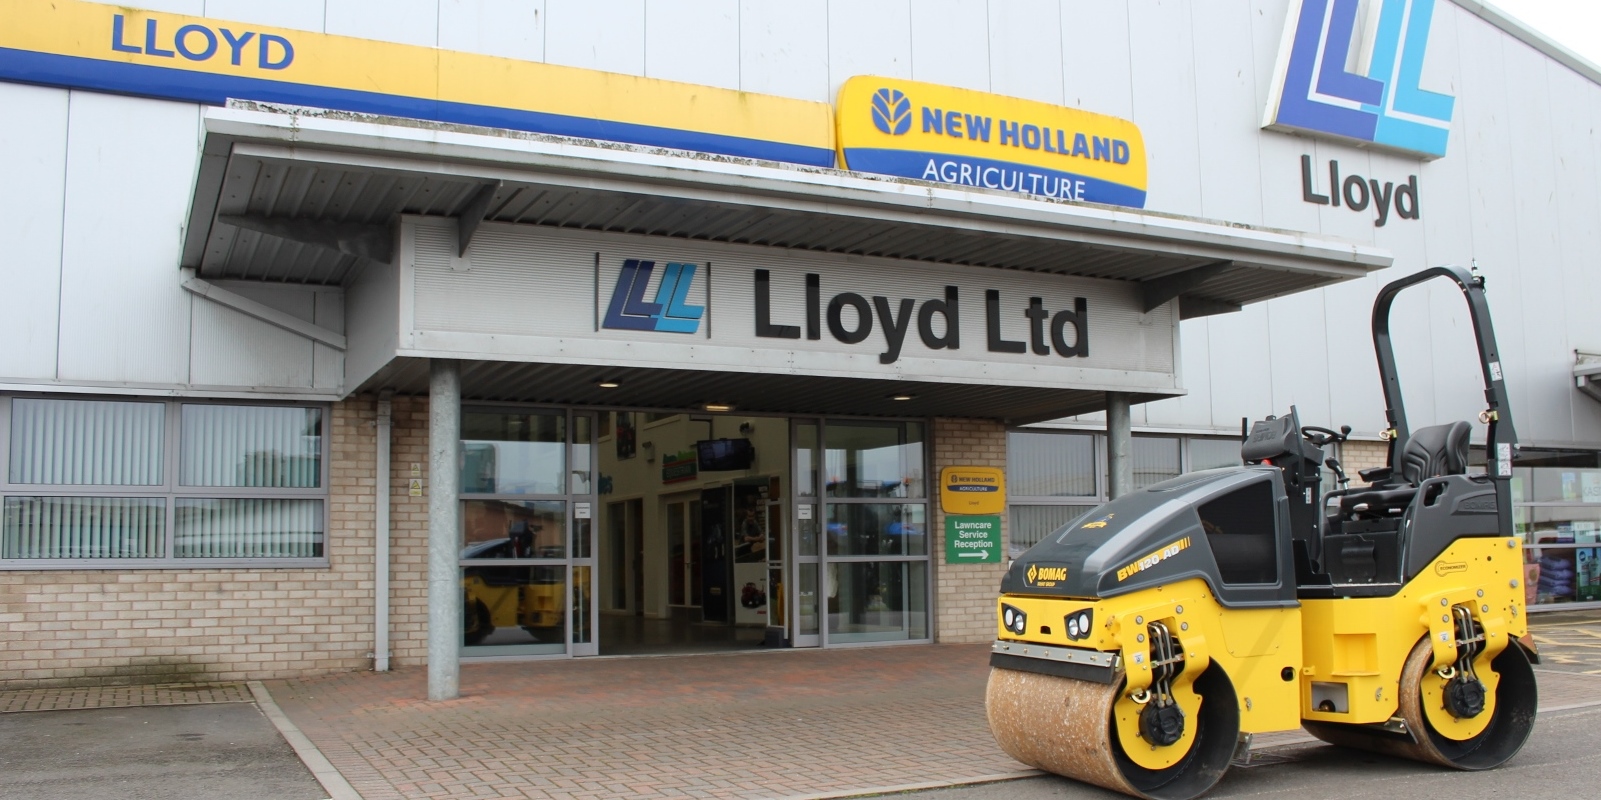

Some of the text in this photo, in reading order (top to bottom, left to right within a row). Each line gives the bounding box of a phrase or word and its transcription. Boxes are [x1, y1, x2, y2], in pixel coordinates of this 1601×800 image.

[112, 14, 294, 70] LLOYD
[922, 106, 1130, 165] NEW HOLLAND
[922, 159, 1086, 201] AGRICULTURE
[1301, 154, 1420, 227] Lloyd
[754, 268, 1090, 364] Lloyd Ltd
[954, 521, 992, 529] Lawncare
[954, 540, 993, 550] Reception
[959, 530, 988, 539] Service
[1037, 567, 1067, 581] BOMAG
